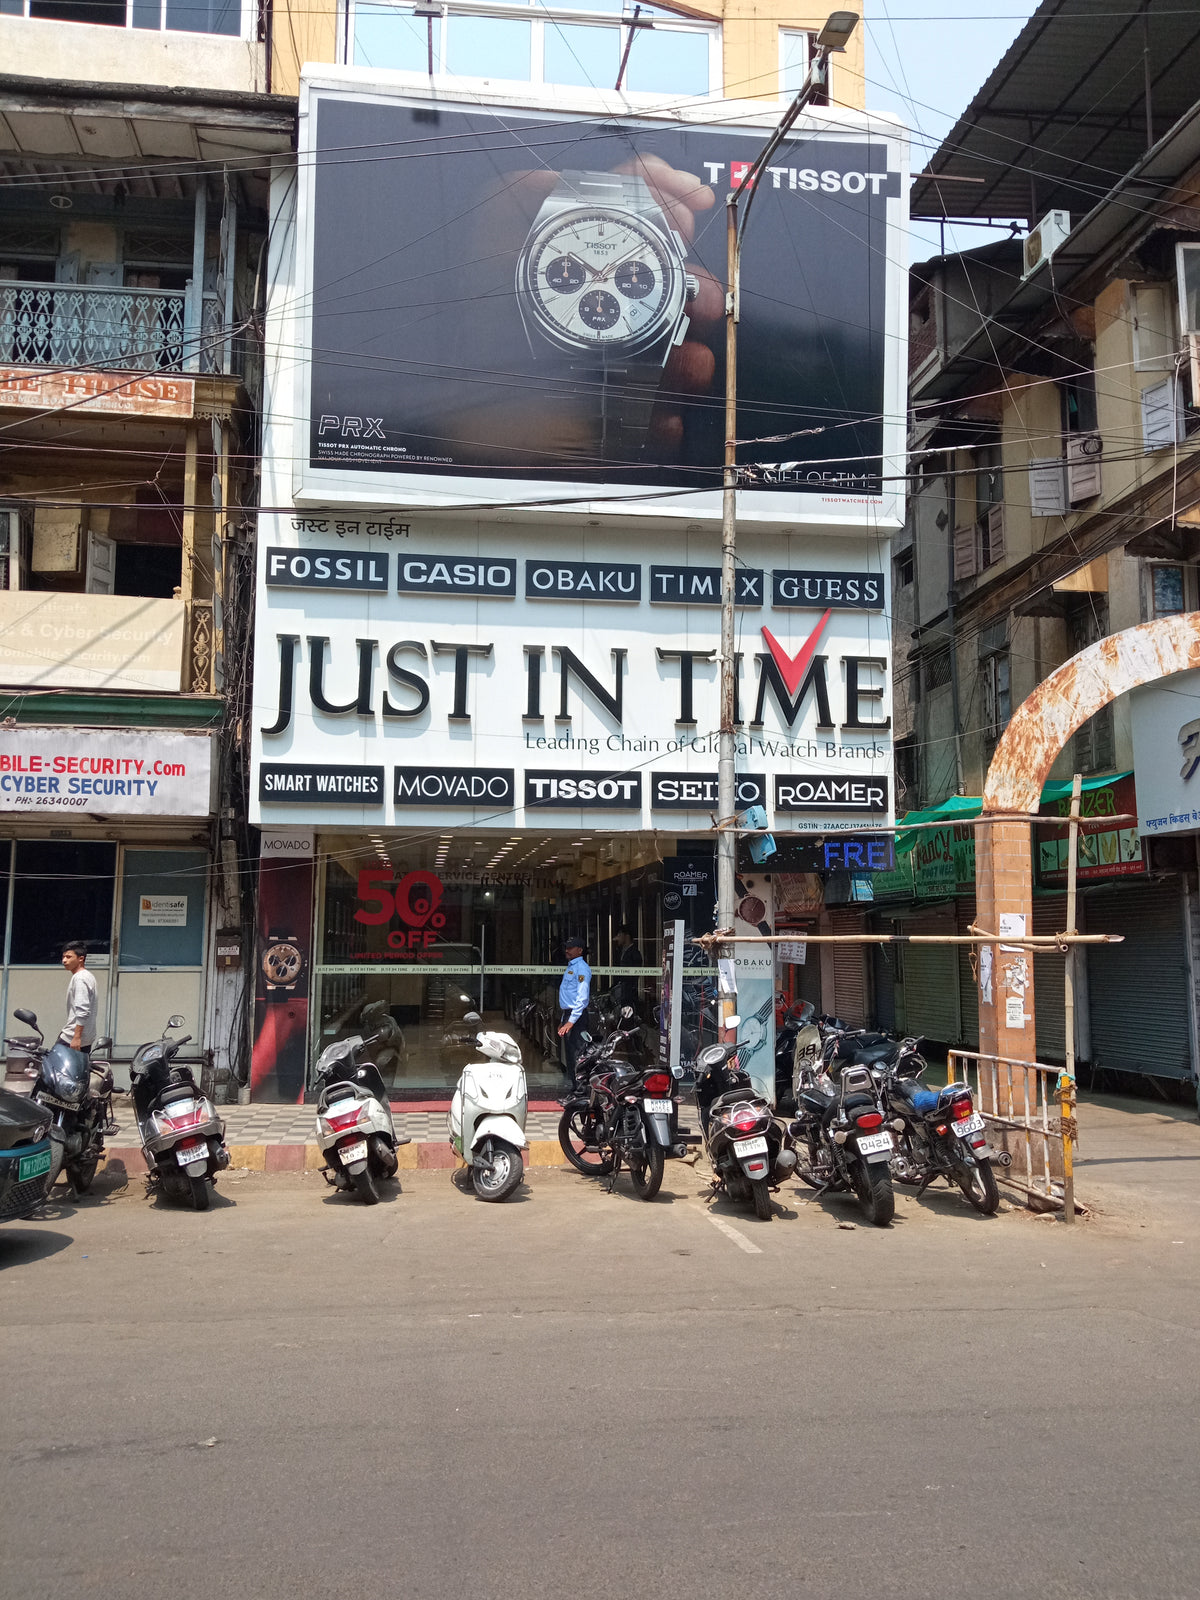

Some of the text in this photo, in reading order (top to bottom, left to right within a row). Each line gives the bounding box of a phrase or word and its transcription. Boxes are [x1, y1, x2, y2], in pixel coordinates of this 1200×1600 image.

[768, 166, 888, 194] TISSOT
[584, 242, 617, 250] TISSOT
[318, 414, 386, 438] PRX
[291, 517, 411, 540] जस्ट इन टाईम
[270, 554, 384, 582] FOSSIL
[404, 562, 511, 587] CASIO
[532, 568, 636, 593] OBAKU
[655, 573, 760, 598] TIMX
[779, 576, 879, 602] GUESS
[260, 633, 494, 735] JUST
[522, 644, 628, 726] IN
[526, 730, 885, 759] Leading Chain of Gloal Watch Brands
[1, 775, 158, 796] CYBER SECURITY
[264, 774, 378, 793] SMART WATCHES
[398, 774, 509, 798] MOVADO
[529, 778, 638, 800] TISSOT
[657, 780, 760, 802] SEIO
[778, 780, 884, 807] ROAMER
[36, 797, 88, 806] 26340007
[264, 840, 310, 850] MOVADO
[824, 842, 893, 868] FRE
[436, 871, 480, 881] ERVICE
[674, 871, 708, 880] ROAMER
[353, 870, 446, 928] 50%
[388, 931, 437, 948] OFF
[957, 1120, 982, 1135] 9603
[861, 1138, 890, 1150] 0424
